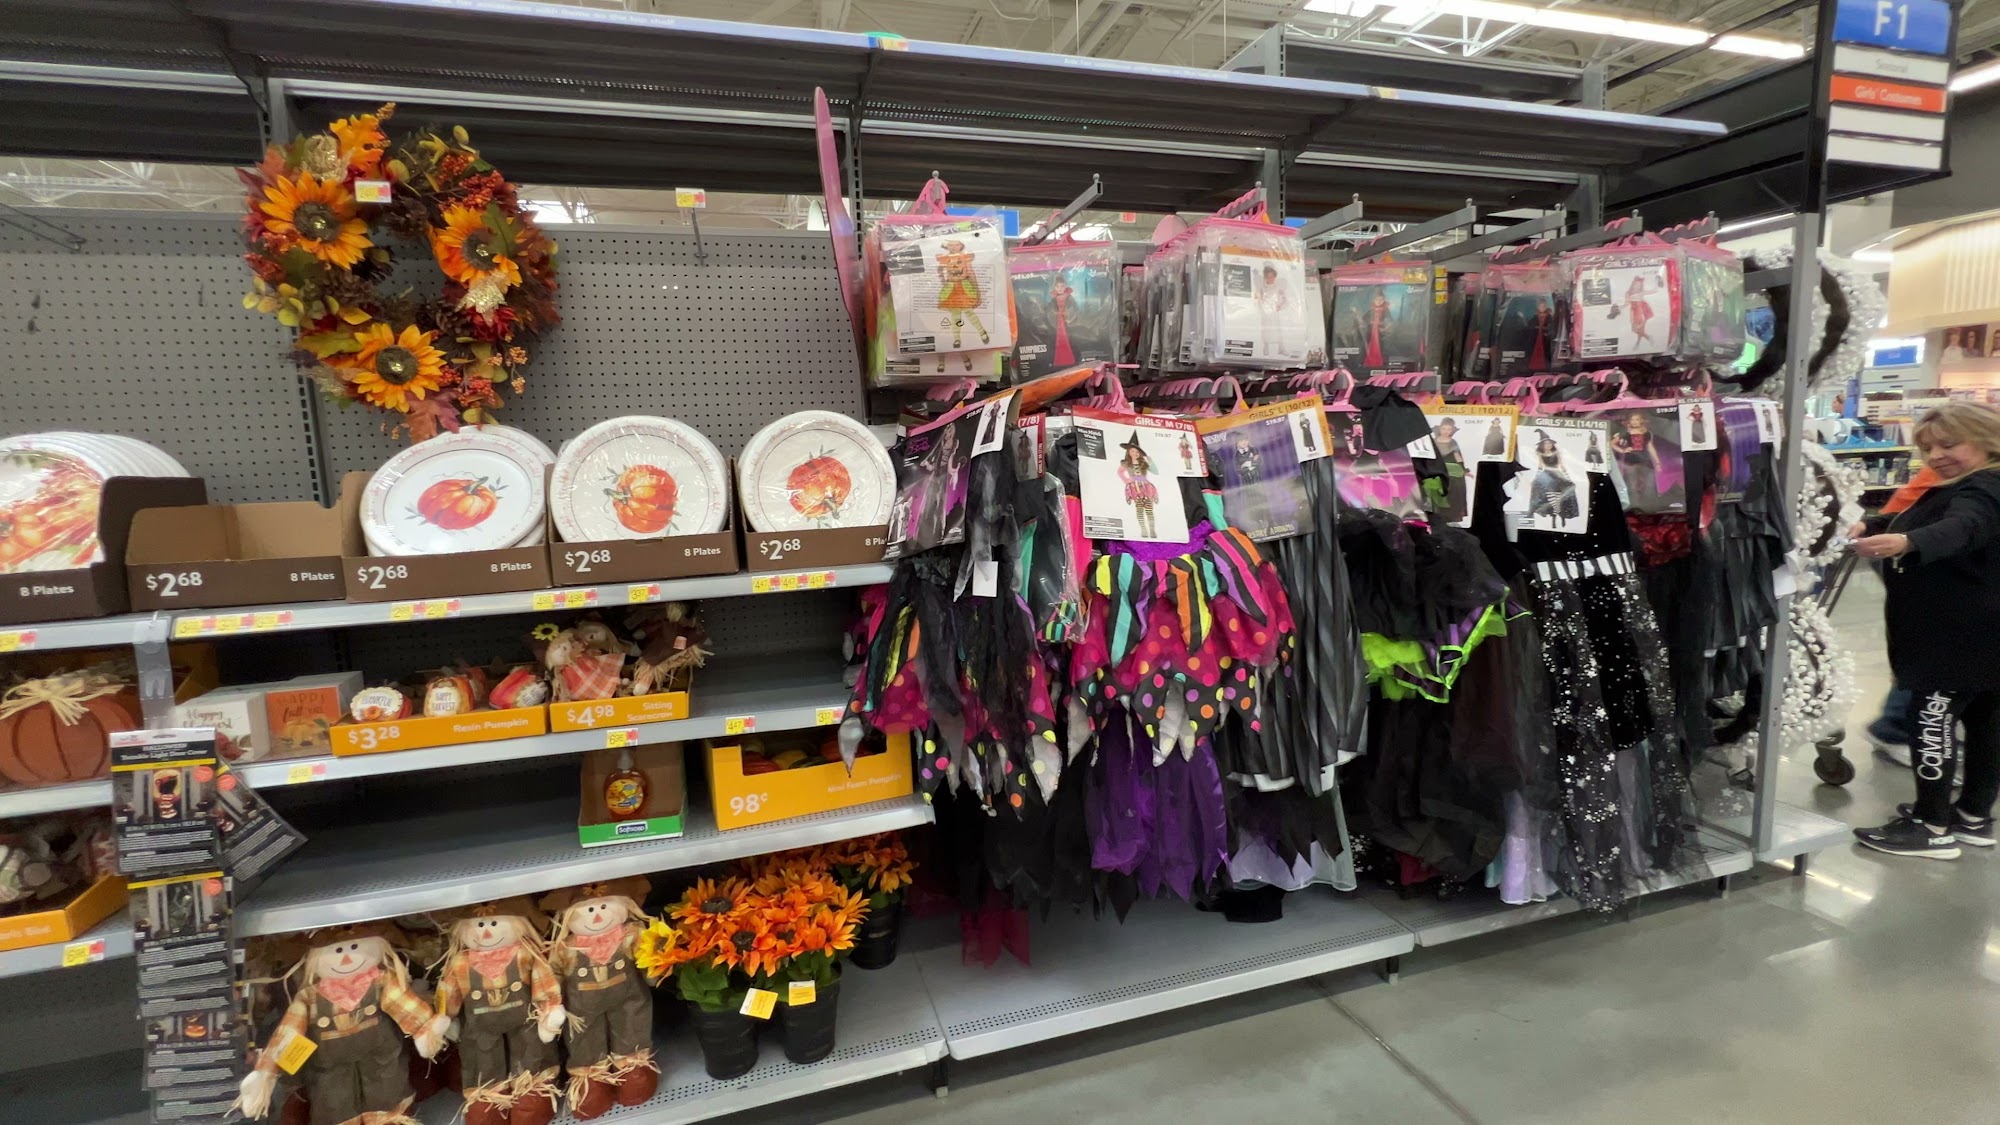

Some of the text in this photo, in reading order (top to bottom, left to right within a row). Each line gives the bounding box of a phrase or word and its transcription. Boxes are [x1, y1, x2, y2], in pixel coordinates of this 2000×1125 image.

[1874, 0, 1908, 39] F1
[1249, 407, 1276, 420] GIRLS'
[1285, 399, 1315, 413] (10/12)
[1018, 415, 1040, 428] (7/8)
[1134, 416, 1195, 432] GIRLS' M (7/8)
[1535, 418, 1607, 430] GIRLS' XL (14/16)
[865, 538, 871, 546] 8
[684, 546, 721, 557] 8 Plates
[491, 561, 532, 573] 8 Plates
[290, 571, 335, 582] 8 Plates
[20, 584, 75, 597] 8 Plates
[643, 702, 673, 711] Sitting
[627, 712, 673, 722] Scarecrow
[453, 718, 529, 733] Resin Pumpkin
[1916, 728, 1943, 780] Calvin
